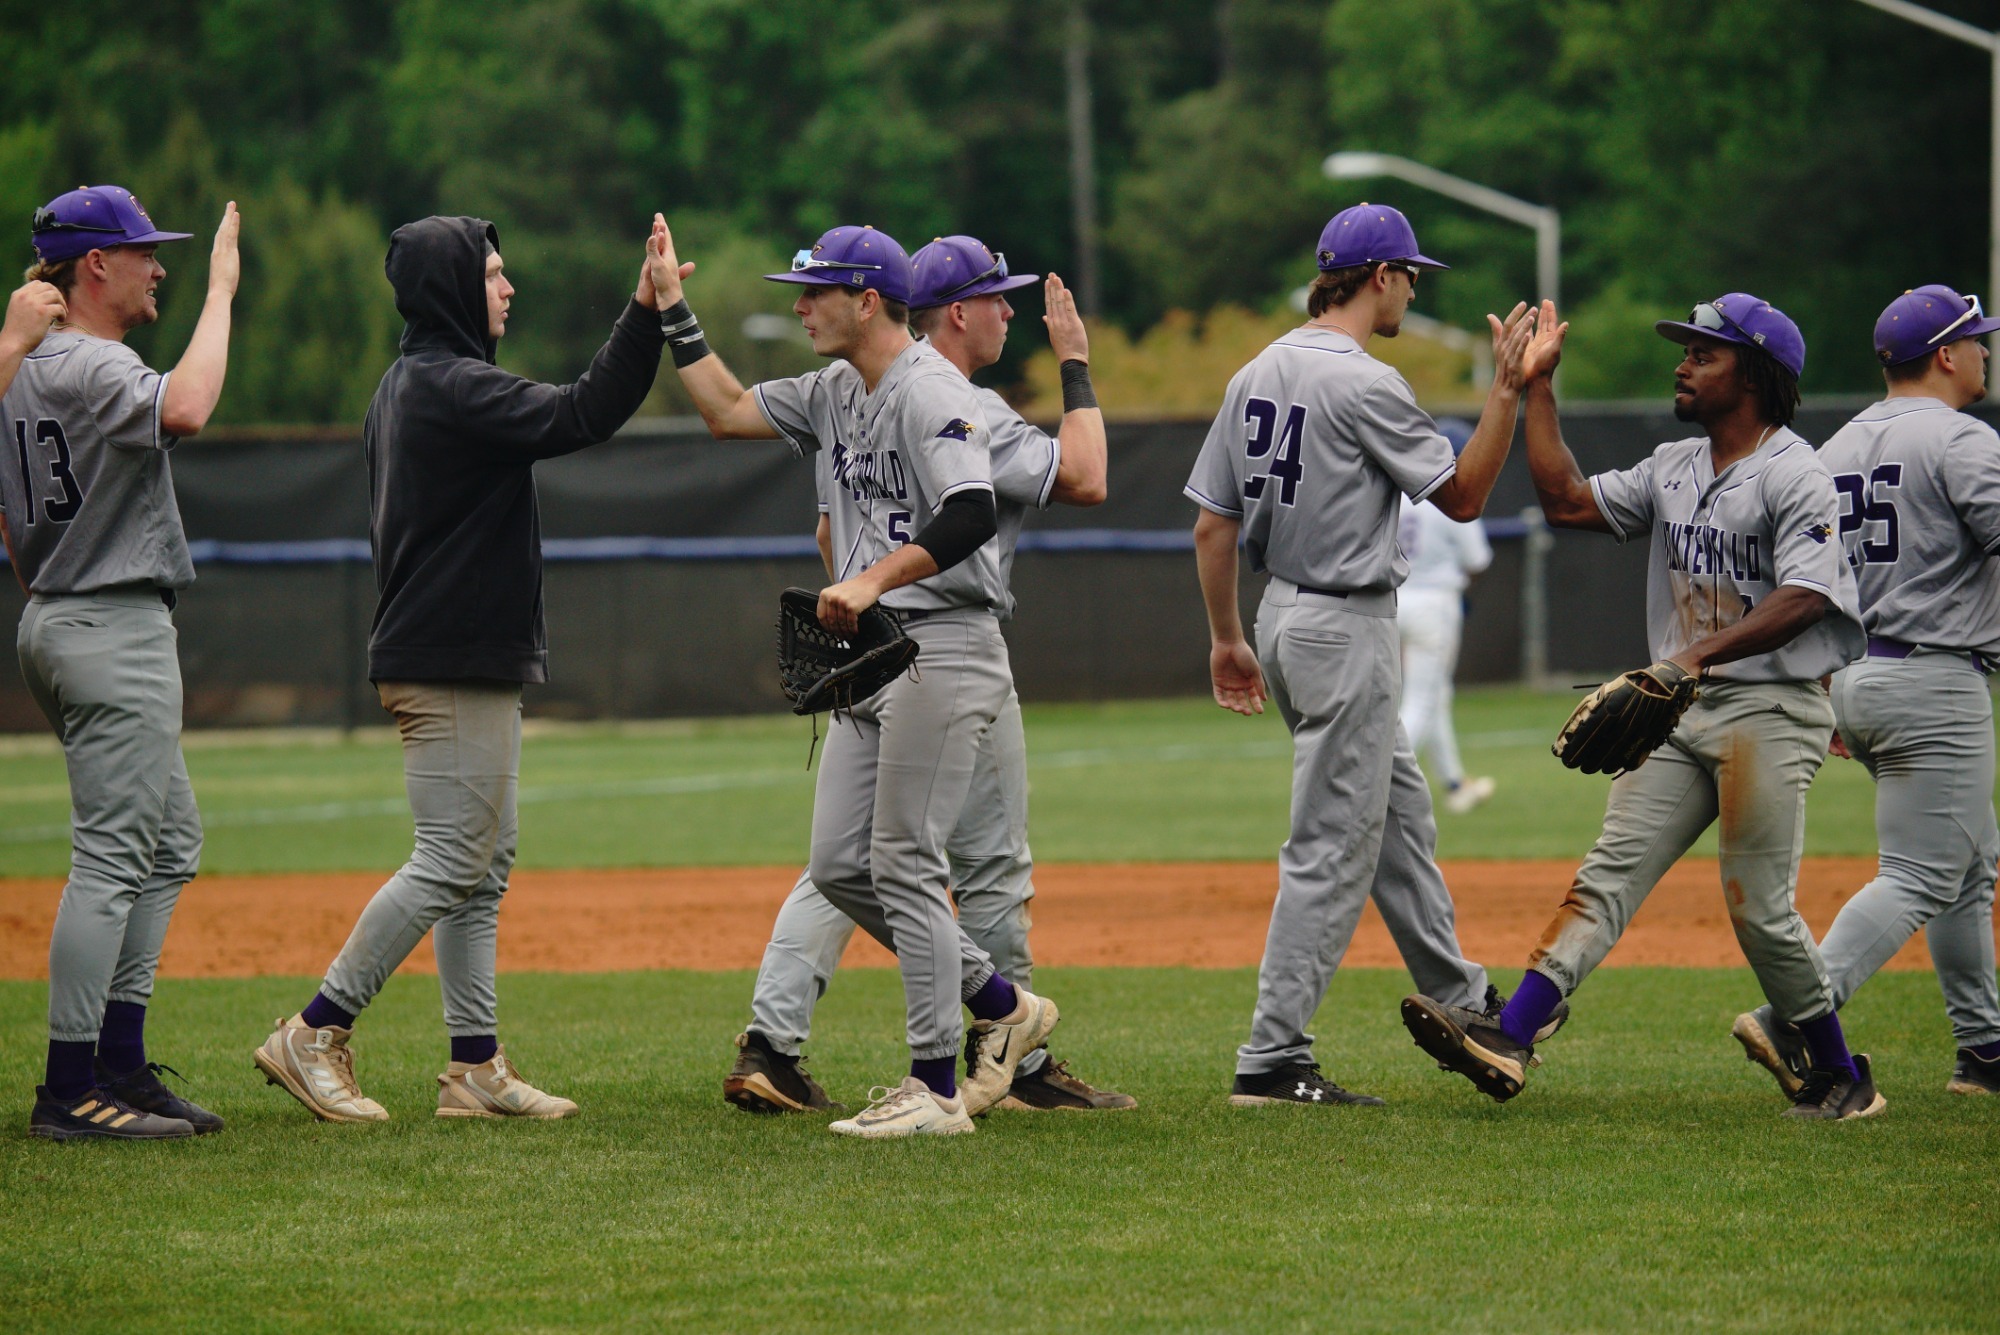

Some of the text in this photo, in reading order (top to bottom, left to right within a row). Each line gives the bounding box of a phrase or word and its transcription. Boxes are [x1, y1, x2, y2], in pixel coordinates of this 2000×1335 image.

[15, 418, 84, 526] 13
[1243, 396, 1308, 508] 24
[887, 510, 912, 549] 5
[1832, 462, 1904, 568] 25
